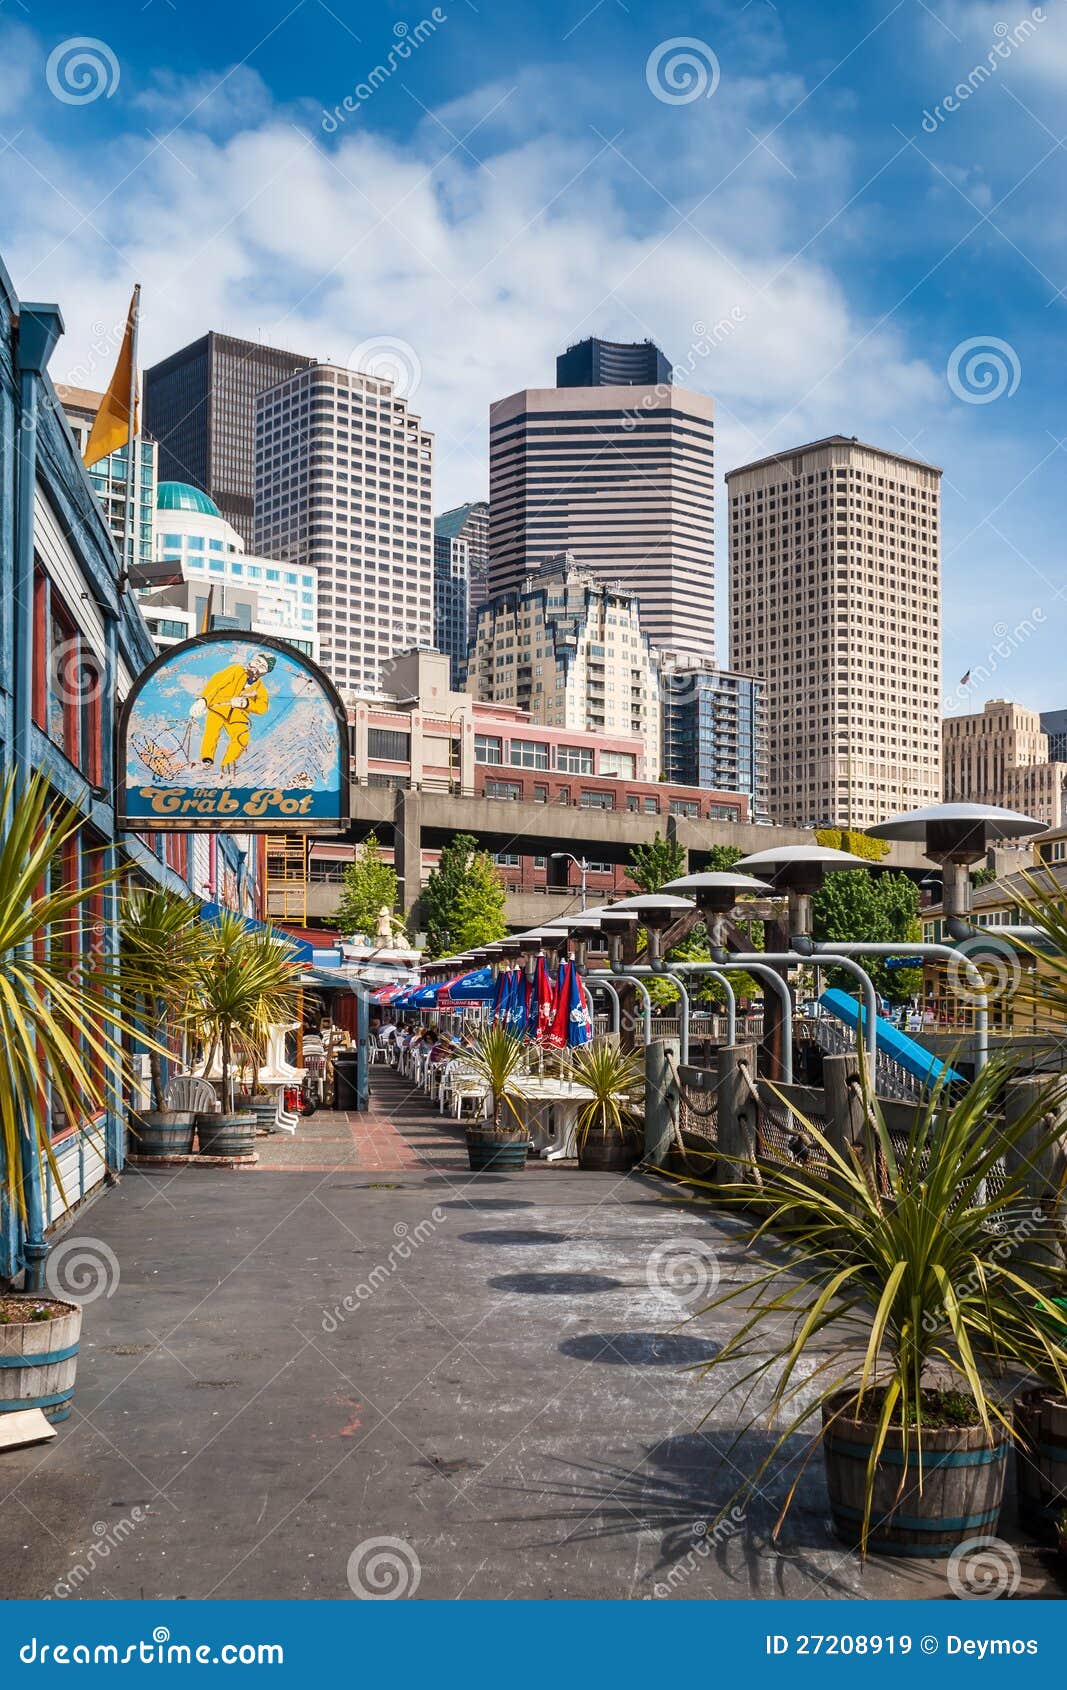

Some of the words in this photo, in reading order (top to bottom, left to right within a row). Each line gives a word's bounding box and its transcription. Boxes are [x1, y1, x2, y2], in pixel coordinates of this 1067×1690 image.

[139, 786, 240, 813] Crab
[243, 789, 314, 816] Pot
[193, 787, 217, 798] the
